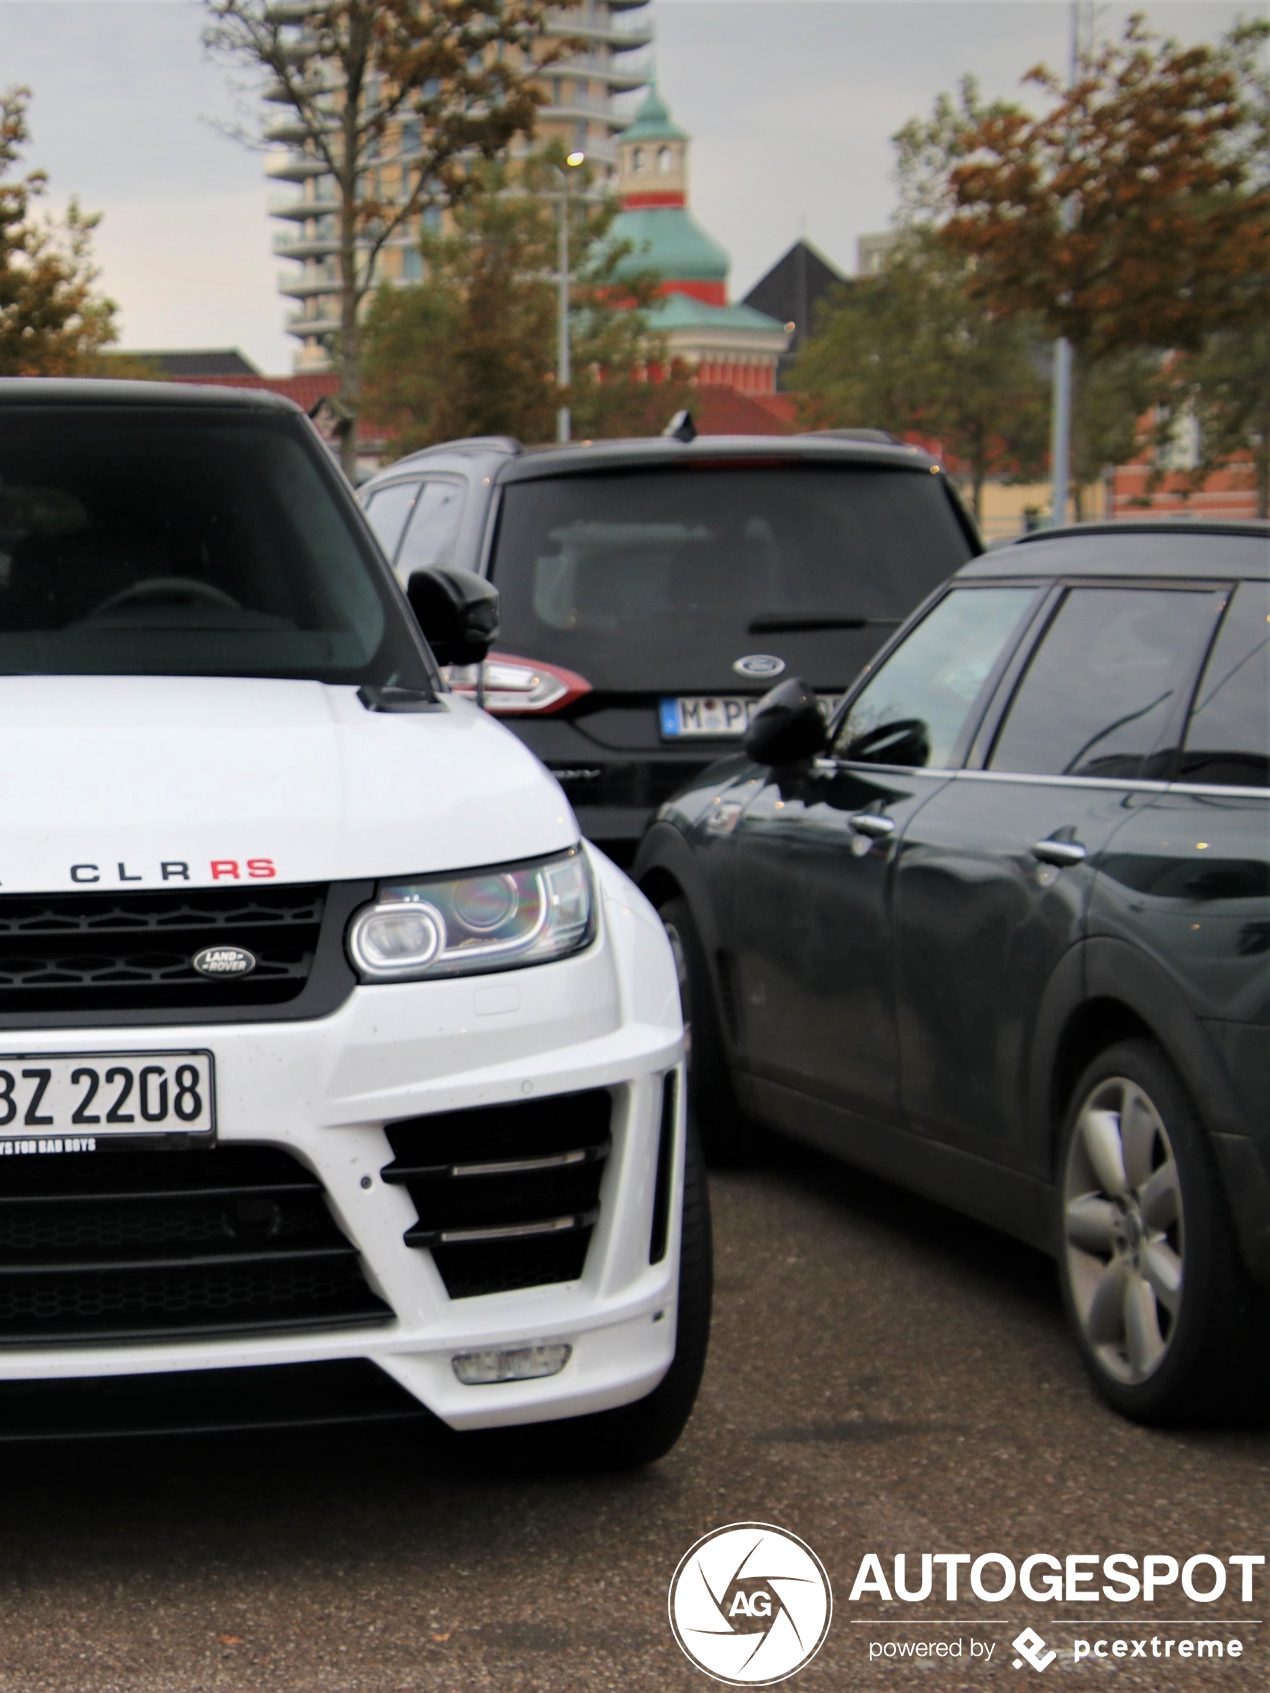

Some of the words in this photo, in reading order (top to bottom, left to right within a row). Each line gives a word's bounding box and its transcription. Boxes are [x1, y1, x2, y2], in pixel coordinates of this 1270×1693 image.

[71, 1064, 203, 1125] 2208
[14, 1140, 37, 1155] FOR
[38, 1139, 63, 1154] BAD
[64, 1138, 96, 1152] BOYS
